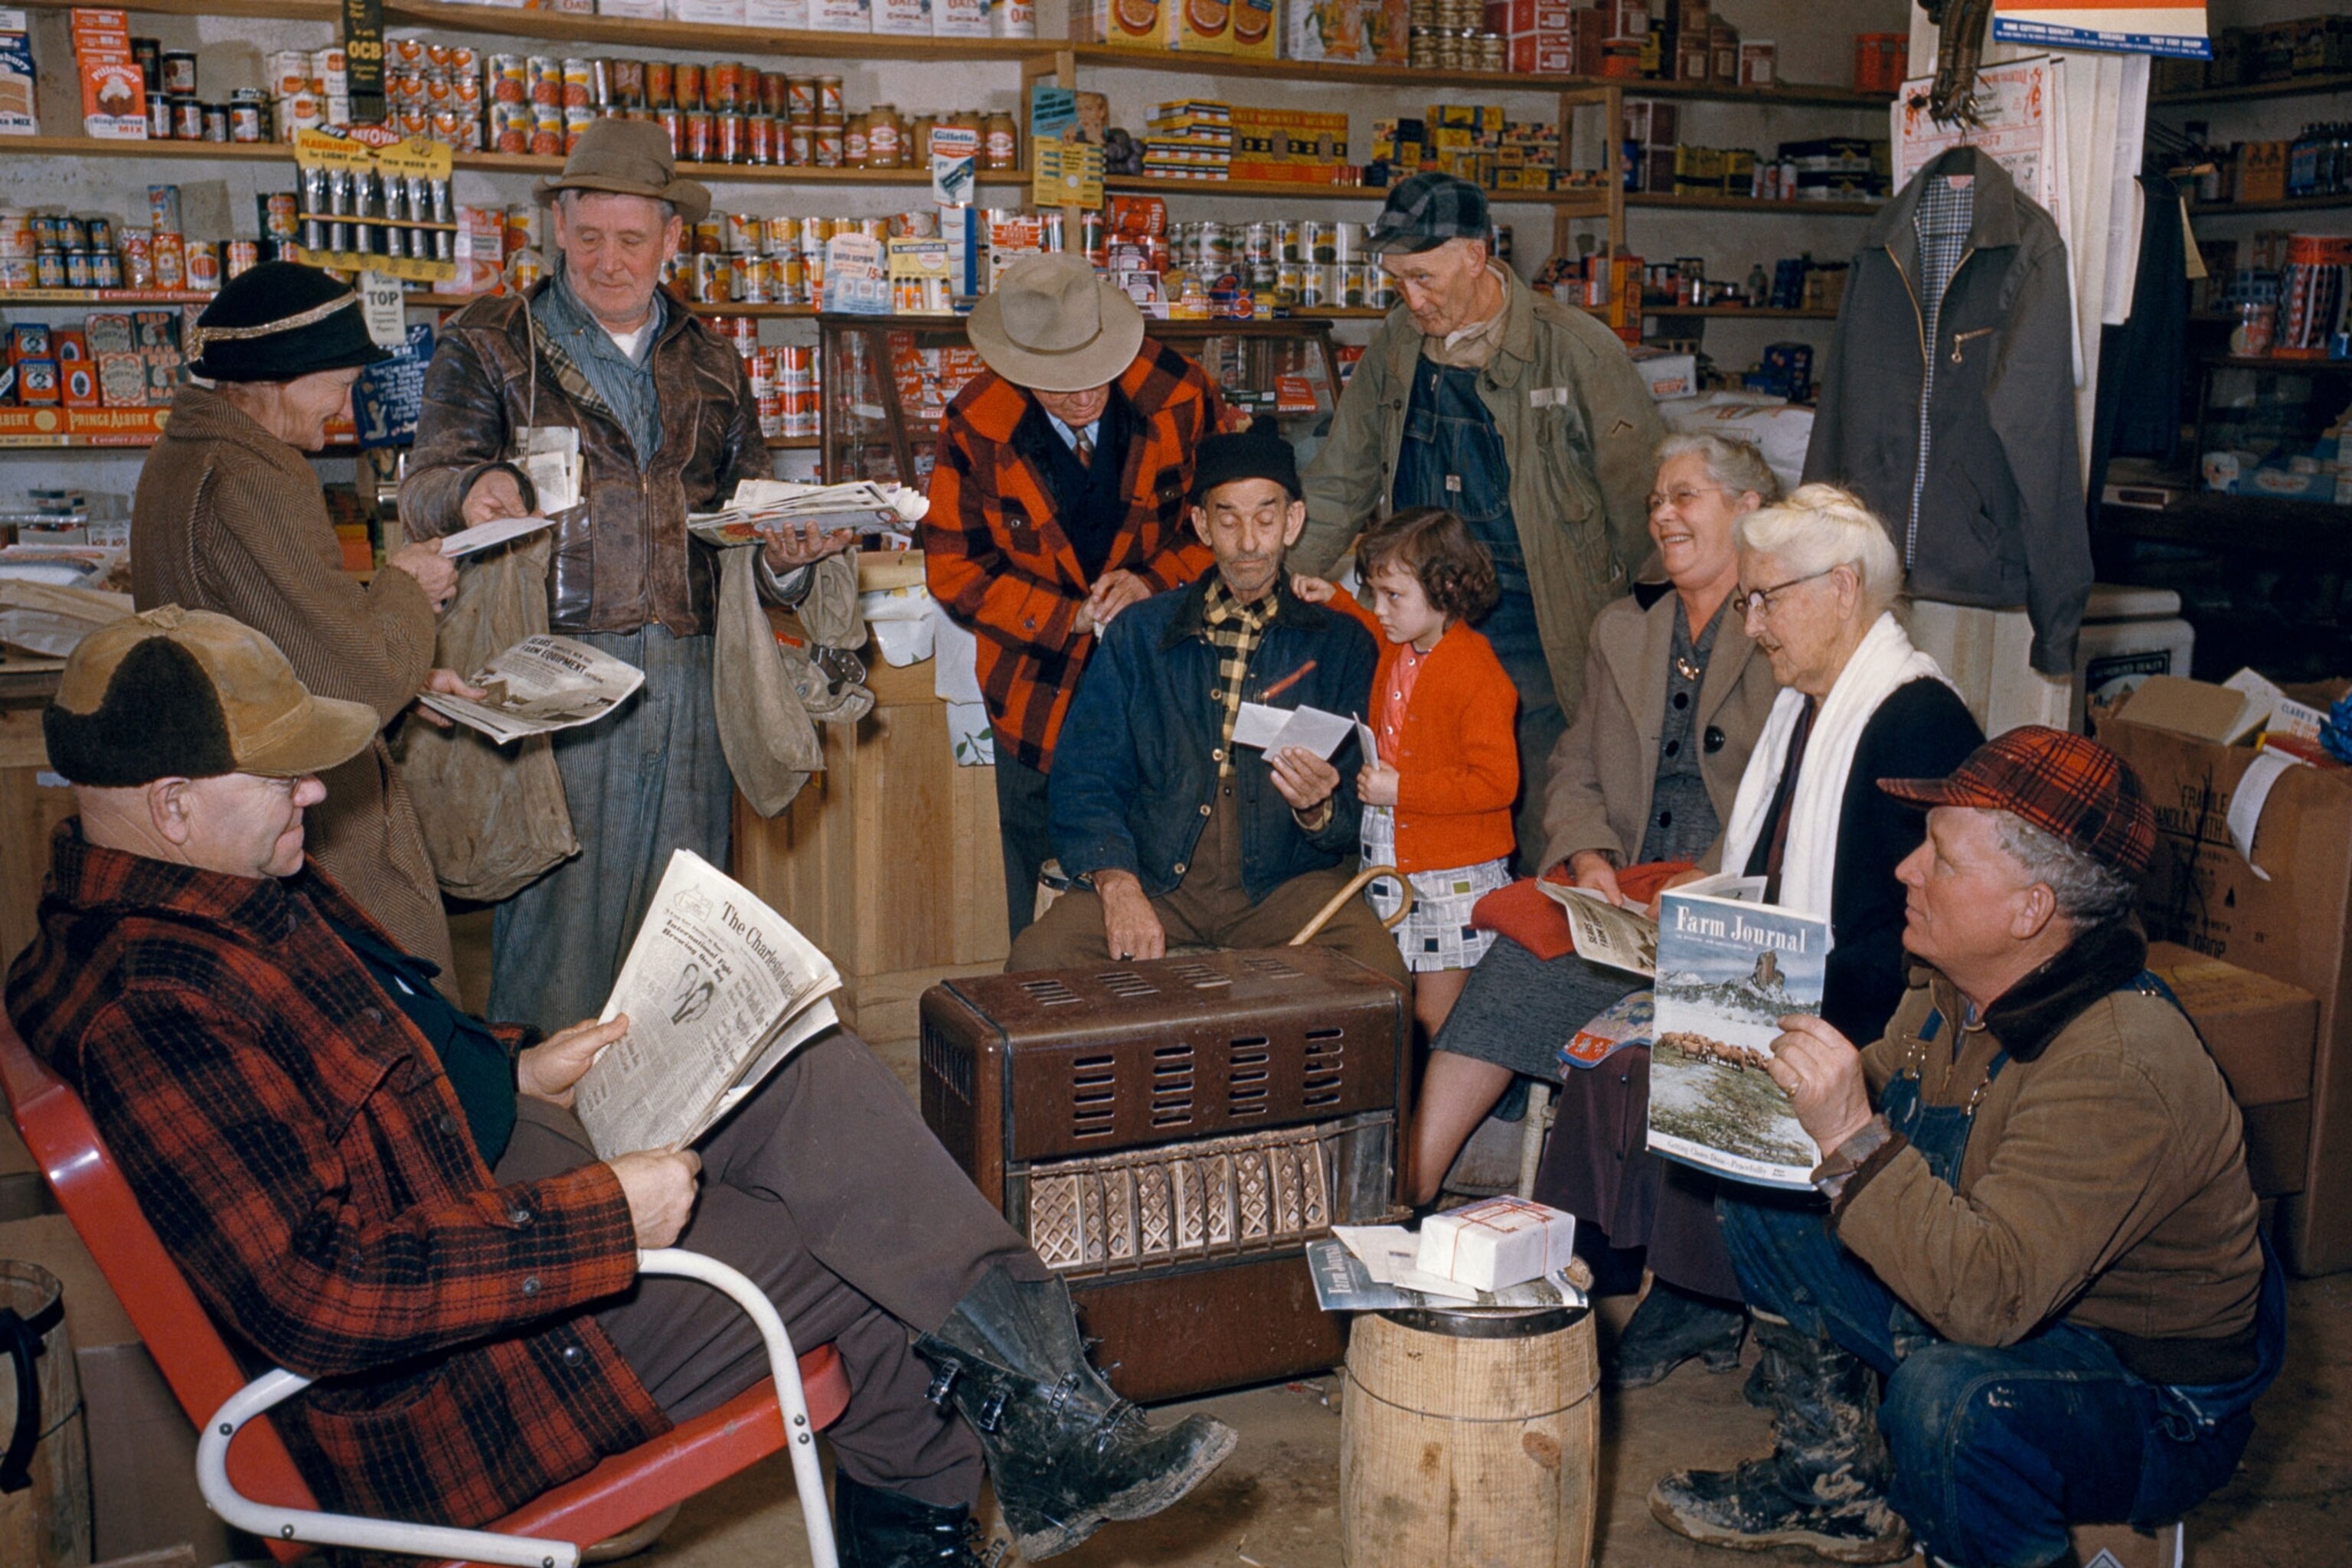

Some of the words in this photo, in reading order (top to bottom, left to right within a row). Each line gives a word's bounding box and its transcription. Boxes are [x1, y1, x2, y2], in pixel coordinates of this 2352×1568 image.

[348, 41, 381, 60] OCB
[0, 52, 31, 71] sbury
[91, 66, 140, 83] Pillsbury
[12, 117, 31, 126] MIX
[118, 125, 143, 133] MIX
[319, 125, 347, 139] BUY
[933, 130, 974, 142] Gillette
[322, 152, 348, 161] LIGHT
[368, 291, 400, 306] TOP
[137, 312, 169, 323] RED
[148, 353, 181, 367] RED
[149, 387, 173, 398] MA
[69, 409, 109, 432] PRINCE
[111, 409, 149, 429] ALBERT
[528, 637, 554, 648] SEARS
[520, 643, 543, 655] FARM
[541, 649, 589, 674] EQUIPMENT
[2181, 784, 2229, 817] FRAILE
[1675, 905, 1726, 938] Farm
[1730, 914, 1806, 954] Journal
[662, 927, 698, 956] Brewing
[666, 919, 718, 960] International
[721, 900, 746, 936] The
[746, 926, 786, 983] Charleston
[1317, 1243, 1346, 1272] Journal
[1327, 1272, 1353, 1295] Farm
